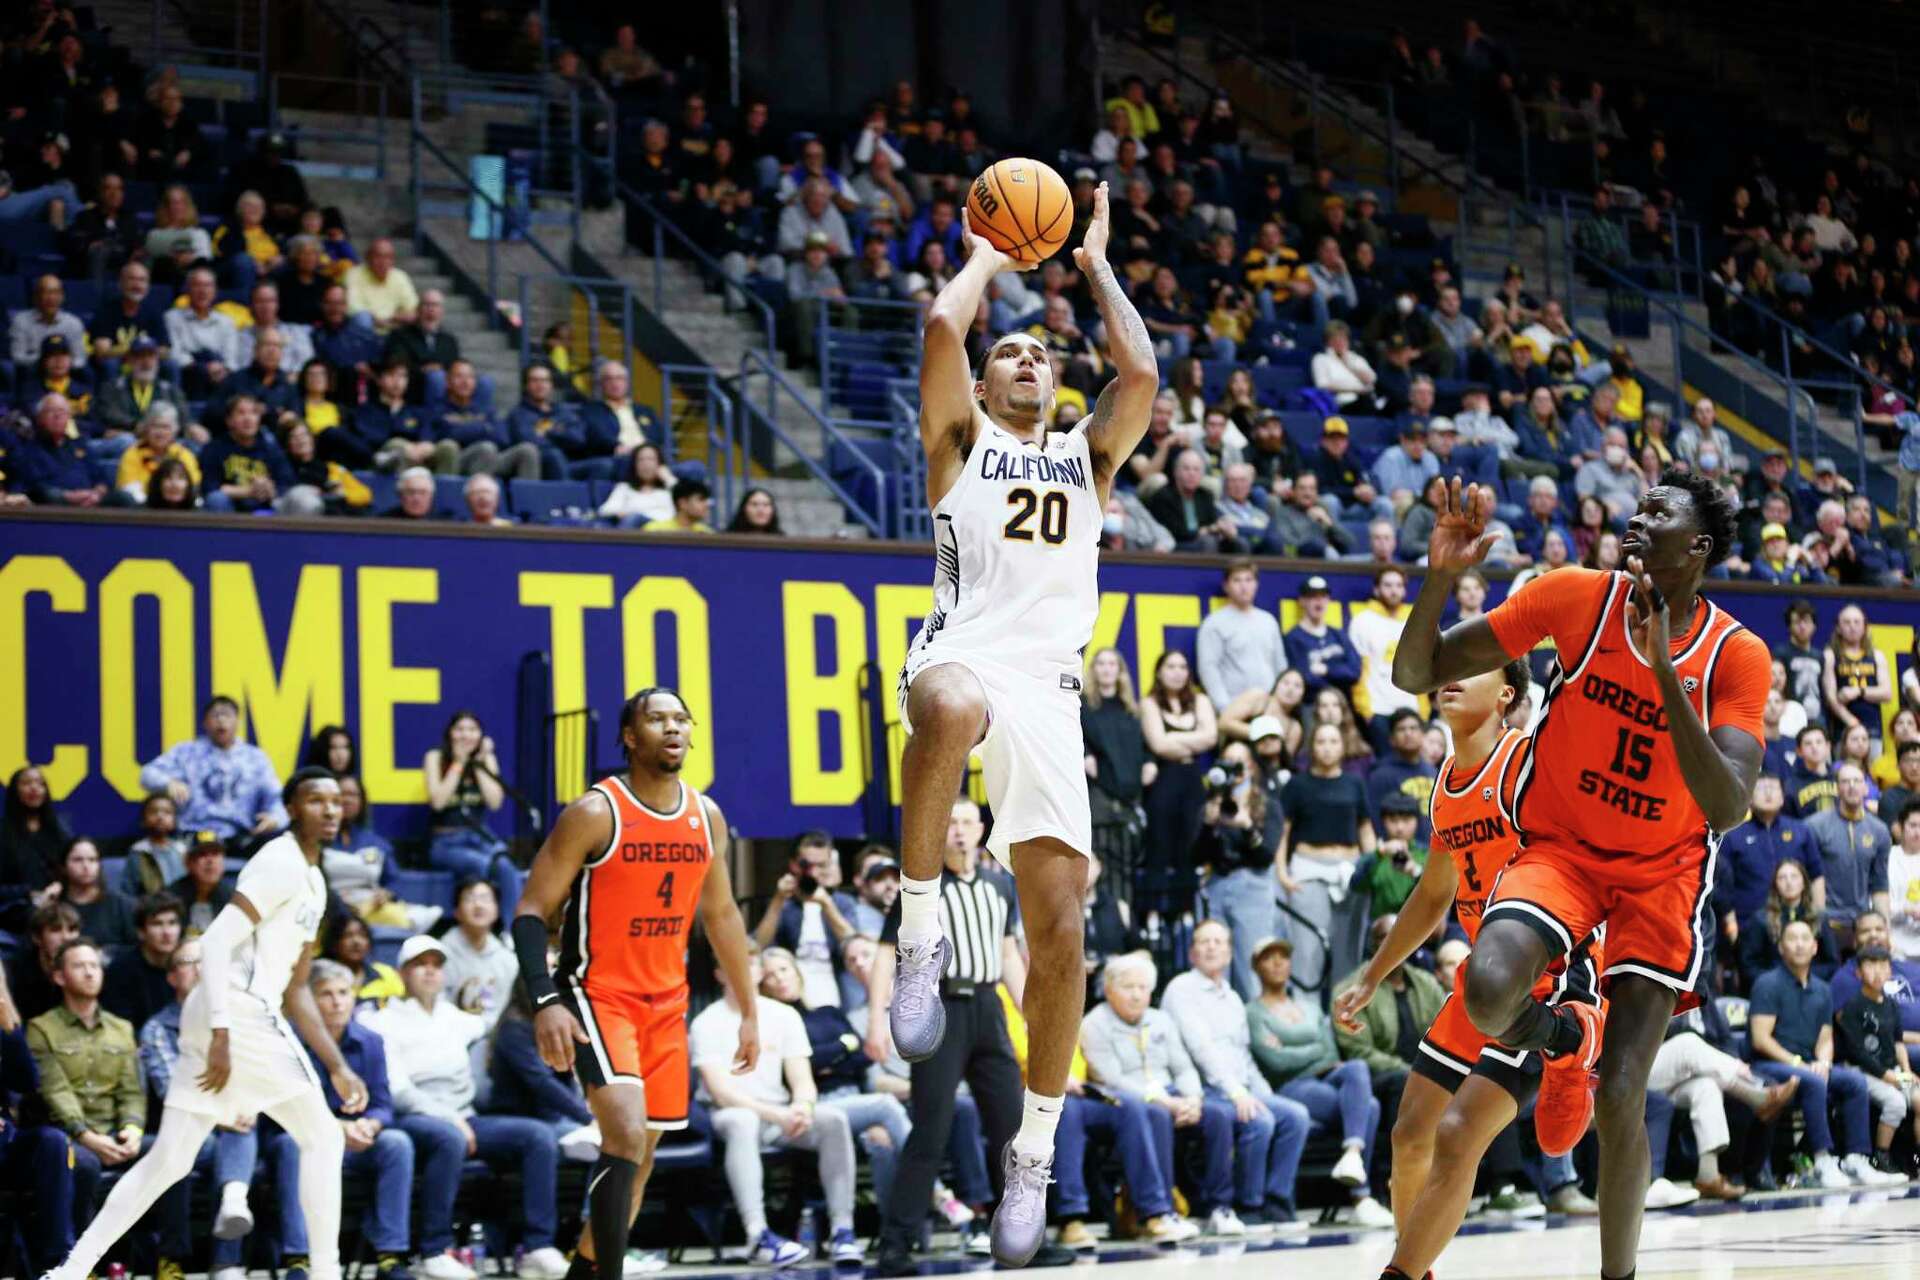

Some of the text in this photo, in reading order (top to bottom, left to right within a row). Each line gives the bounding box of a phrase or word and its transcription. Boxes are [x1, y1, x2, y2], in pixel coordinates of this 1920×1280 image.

[1004, 488, 1069, 546] 20
[518, 571, 715, 805] TO
[1582, 673, 1669, 732] OREGO
[1610, 726, 1655, 782] 15
[1578, 769, 1667, 821] STATE
[622, 843, 707, 863] OREGON
[1438, 815, 1506, 851] REGON
[656, 871, 674, 909] 4
